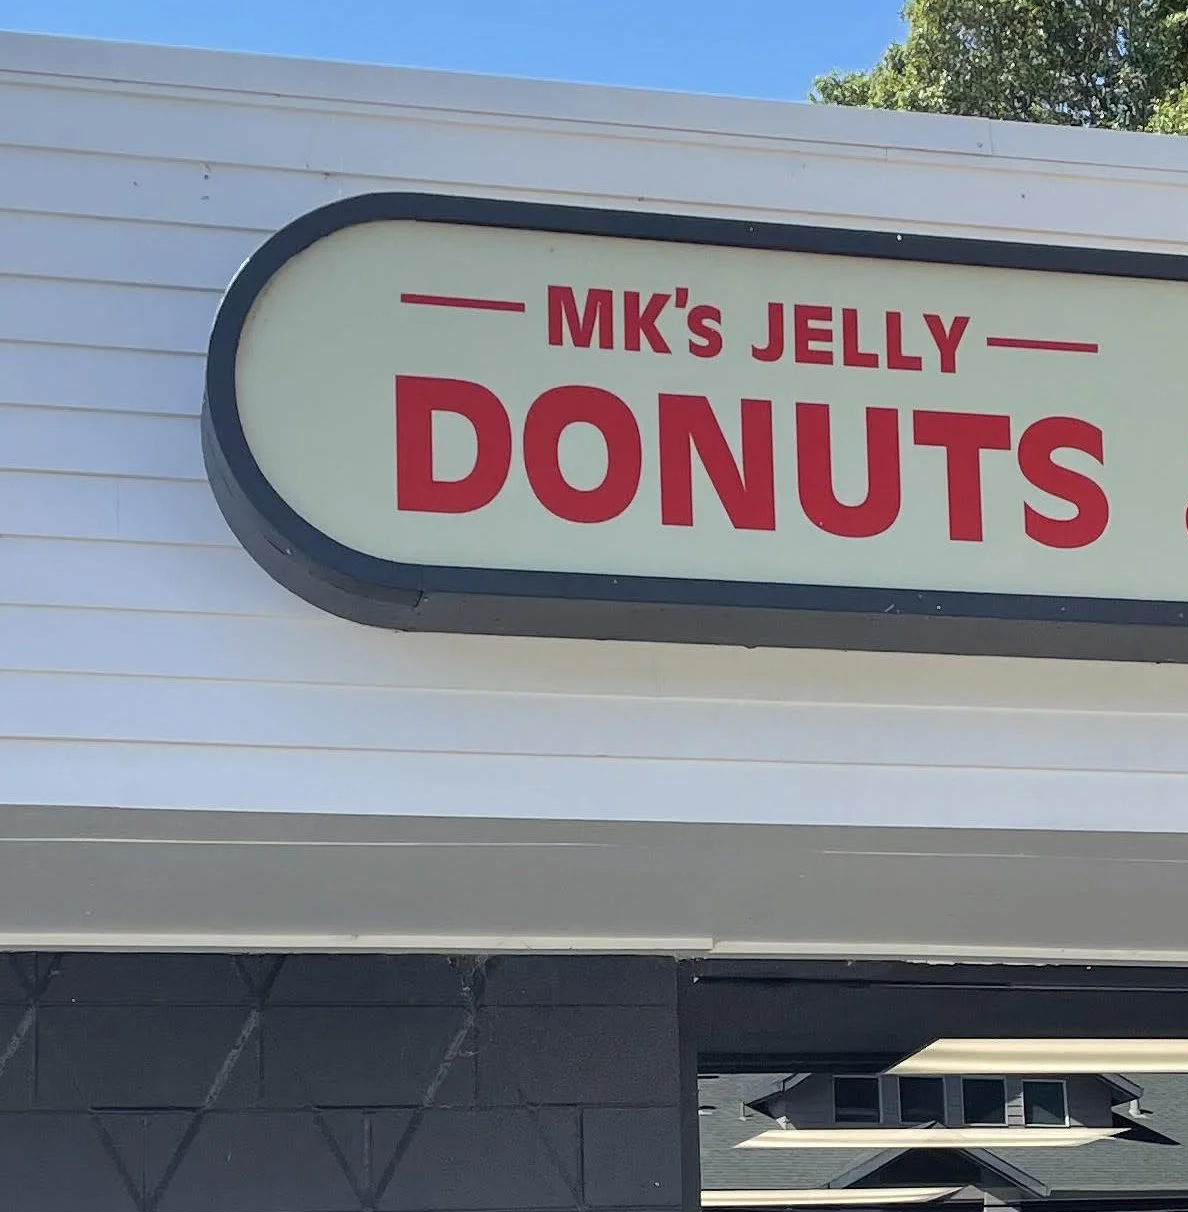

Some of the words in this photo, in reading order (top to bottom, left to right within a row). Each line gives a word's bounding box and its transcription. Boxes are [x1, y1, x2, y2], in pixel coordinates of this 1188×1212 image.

[547, 285, 723, 358] MK's
[751, 302, 971, 374] JELLY
[395, 374, 1110, 549] DONUTS
